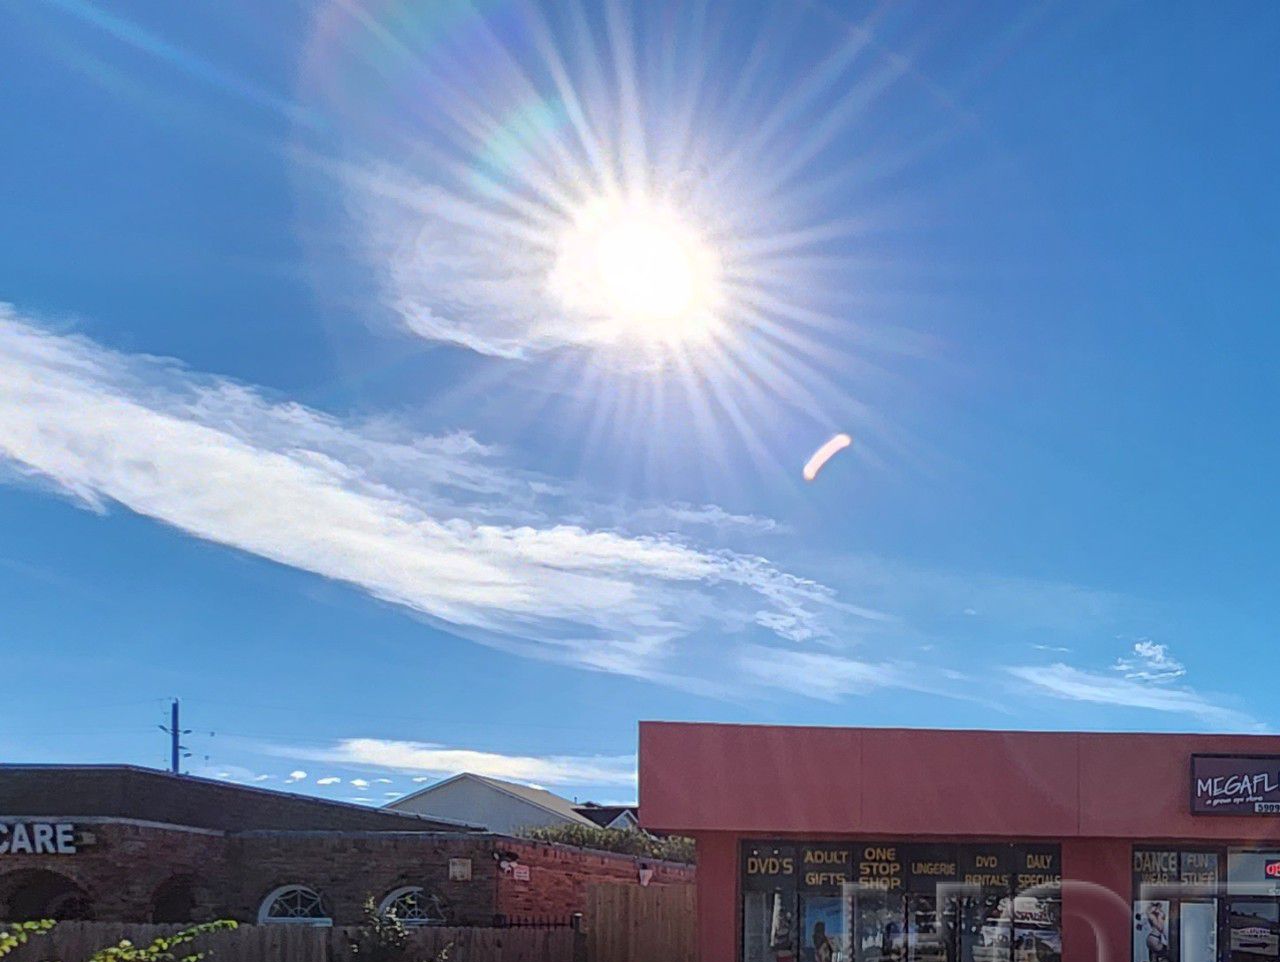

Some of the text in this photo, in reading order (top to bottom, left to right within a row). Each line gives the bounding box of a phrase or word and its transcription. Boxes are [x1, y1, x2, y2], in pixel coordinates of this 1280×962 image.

[804, 850, 848, 864] ADULT
[864, 847, 896, 861] ONE
[1026, 853, 1053, 868] DAILY
[747, 857, 793, 875] DVD'S
[911, 861, 955, 876] LINGERIE
[975, 855, 998, 868] DVD
[1134, 851, 1177, 872] DANCE
[1187, 855, 1209, 868] FUN
[859, 862, 900, 876] STOP
[805, 872, 845, 886] GIFTS
[858, 876, 900, 890] SHOP
[964, 873, 1009, 887] RENTALS
[1017, 873, 1061, 888] SPECIALS
[1142, 873, 1168, 886] WEAR
[1181, 871, 1215, 885] STUFF
